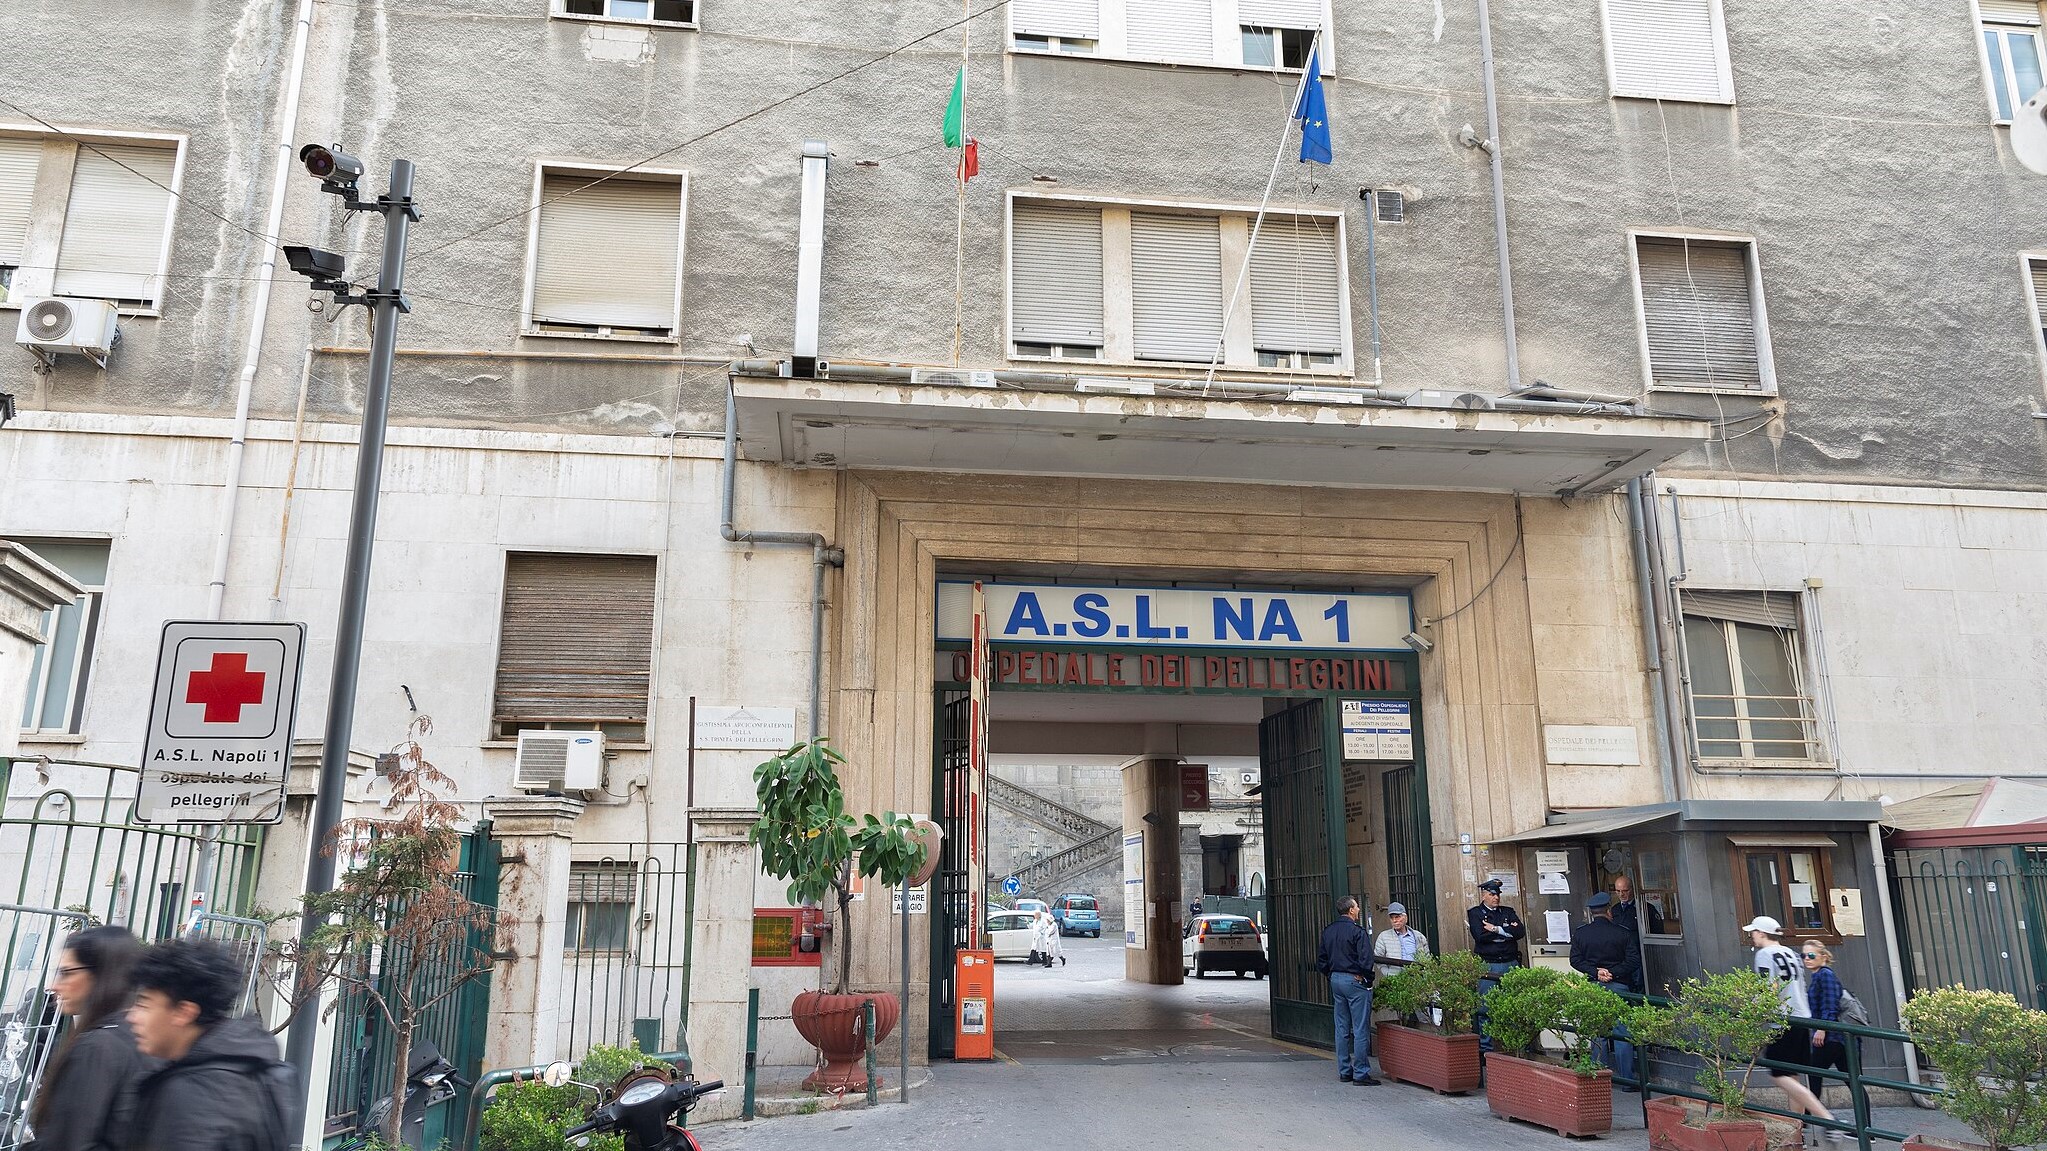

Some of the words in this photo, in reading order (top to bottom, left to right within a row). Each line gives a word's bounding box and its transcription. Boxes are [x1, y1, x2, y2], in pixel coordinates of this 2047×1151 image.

[1003, 591, 1189, 639] A.S.L.
[1213, 597, 1303, 642] NA
[1324, 600, 1351, 643] 1
[1141, 653, 1190, 688] DEI
[1205, 656, 1392, 692] PELLEGRINI
[1547, 737, 1583, 745] OSPEDALE
[154, 748, 203, 762] A.S.L.
[211, 749, 267, 764] Napoli
[273, 750, 280, 762] 1
[242, 771, 267, 785] dei
